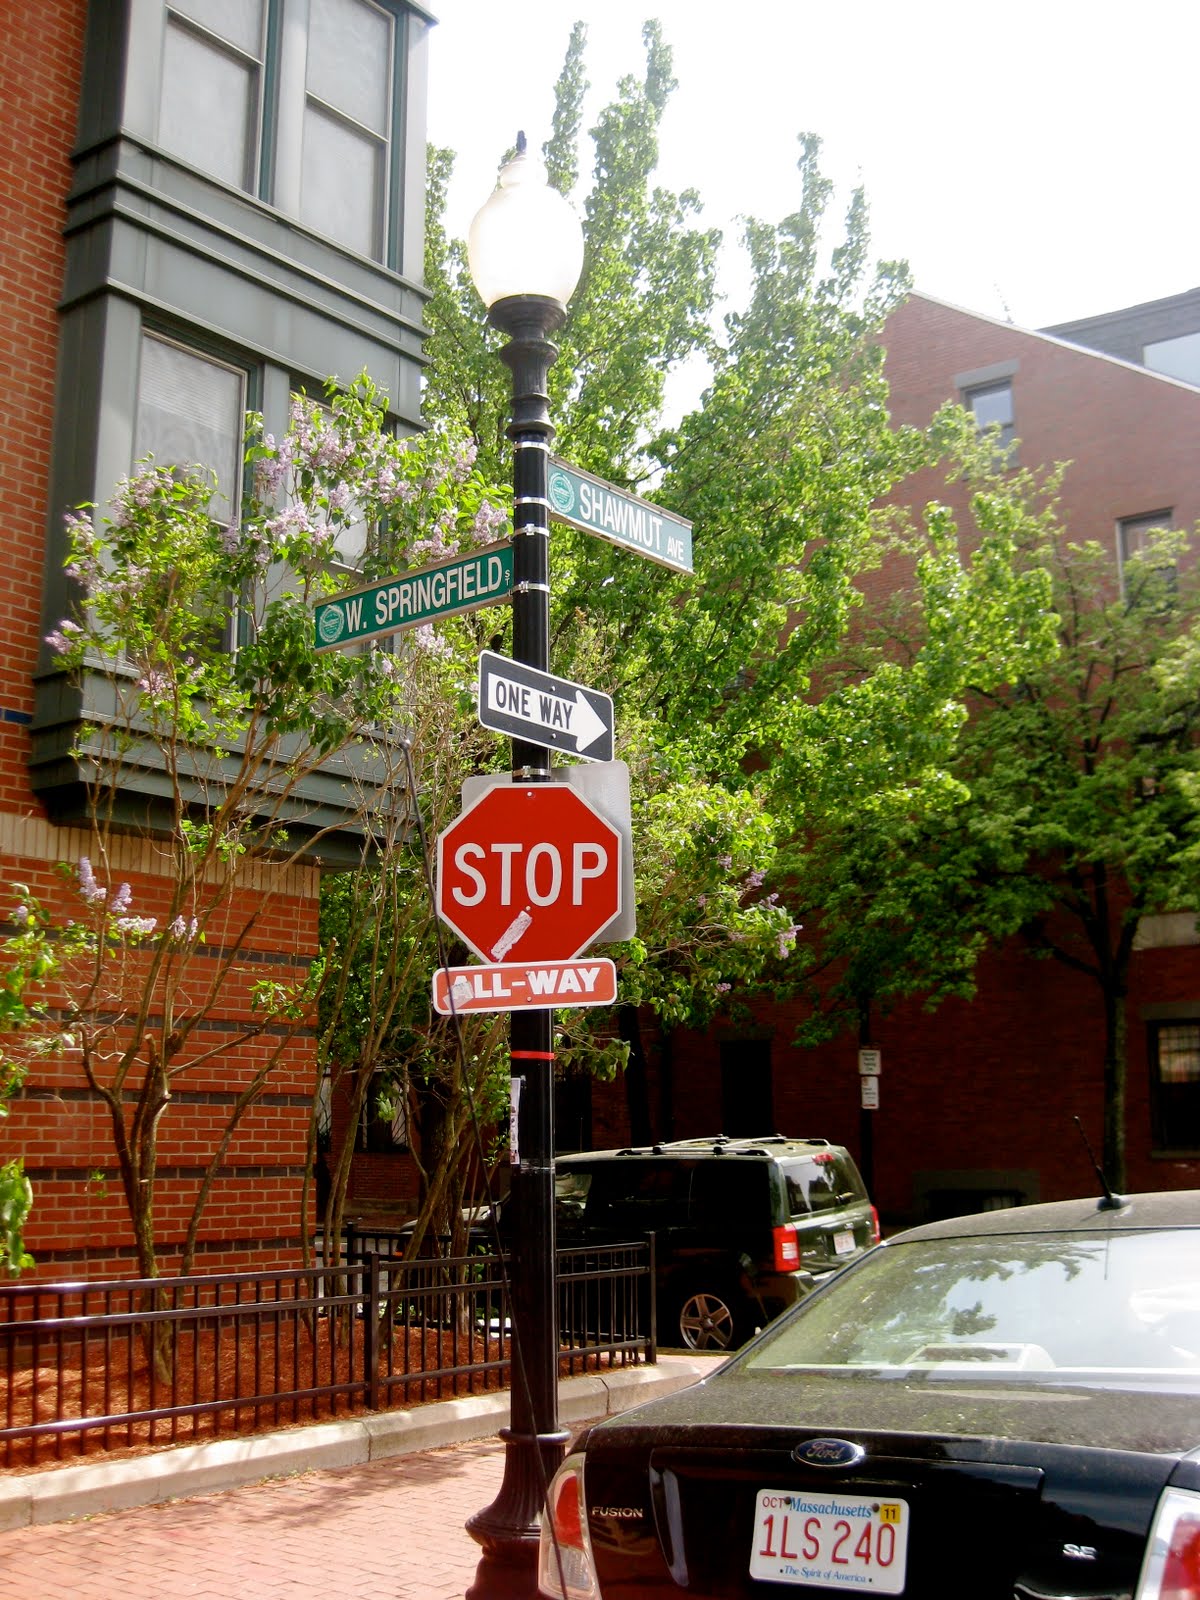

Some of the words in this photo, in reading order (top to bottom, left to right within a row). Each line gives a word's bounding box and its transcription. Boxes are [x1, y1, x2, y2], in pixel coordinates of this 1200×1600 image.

[579, 482, 662, 550] SHAWMUT
[667, 536, 684, 561] AVE
[345, 597, 367, 633] W.
[375, 556, 503, 626] SPRINGFIELD
[495, 680, 531, 717] ONE
[539, 698, 573, 730] WAY
[452, 842, 608, 906] STOP
[446, 967, 600, 1000] ALL-WAY
[807, 1441, 844, 1459] Ford
[592, 1506, 643, 1518] FUSION
[762, 1496, 784, 1508] OCT
[790, 1497, 872, 1518] Massachusetts
[884, 1507, 896, 1520] 11
[760, 1514, 821, 1560] 1LS
[831, 1520, 896, 1567] 240
[784, 1565, 799, 1575] The
[800, 1567, 821, 1578] Spirit
[823, 1570, 832, 1579] of
[833, 1570, 866, 1583] America
